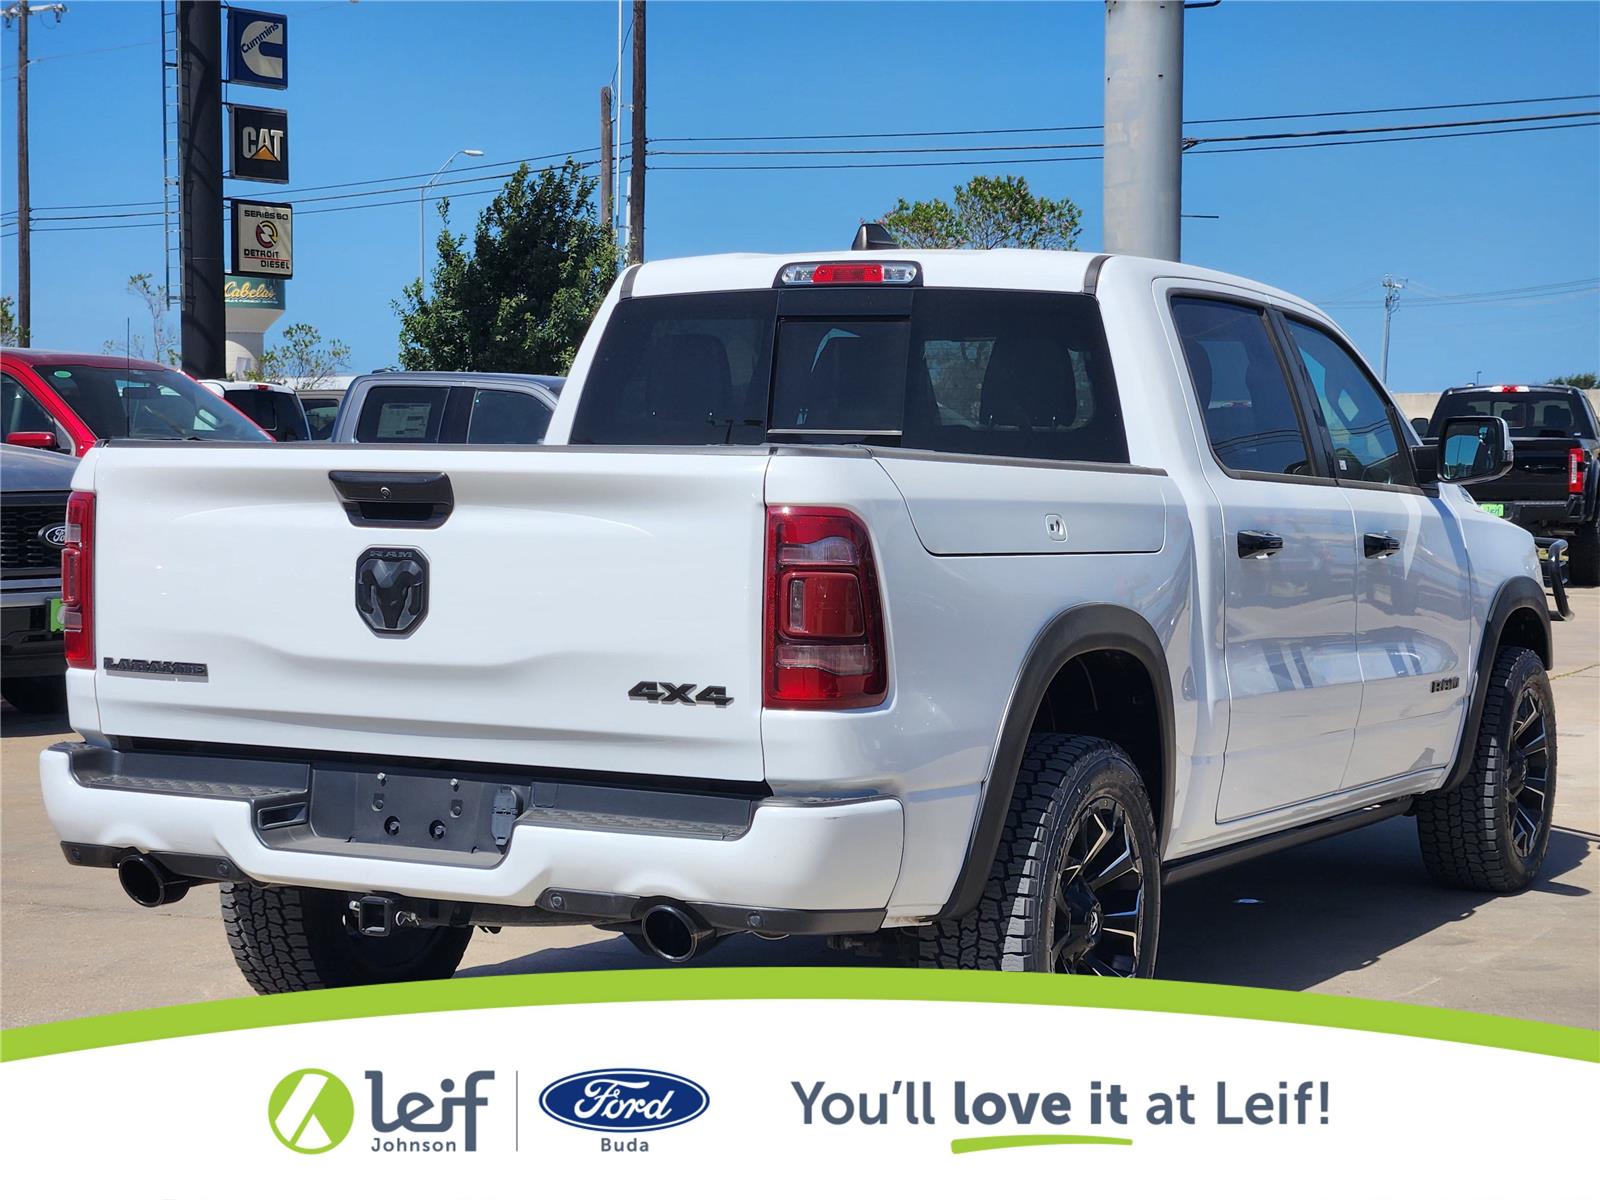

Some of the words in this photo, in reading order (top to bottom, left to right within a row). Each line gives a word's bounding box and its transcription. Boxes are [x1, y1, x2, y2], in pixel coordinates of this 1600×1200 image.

[241, 23, 279, 53] Cummins
[242, 126, 284, 161] CAT
[244, 210, 275, 219] SERIES
[243, 248, 279, 258] DETROIT
[260, 260, 290, 269] DIESEL
[1431, 677, 1460, 693] RAM
[628, 681, 734, 707] 4X4
